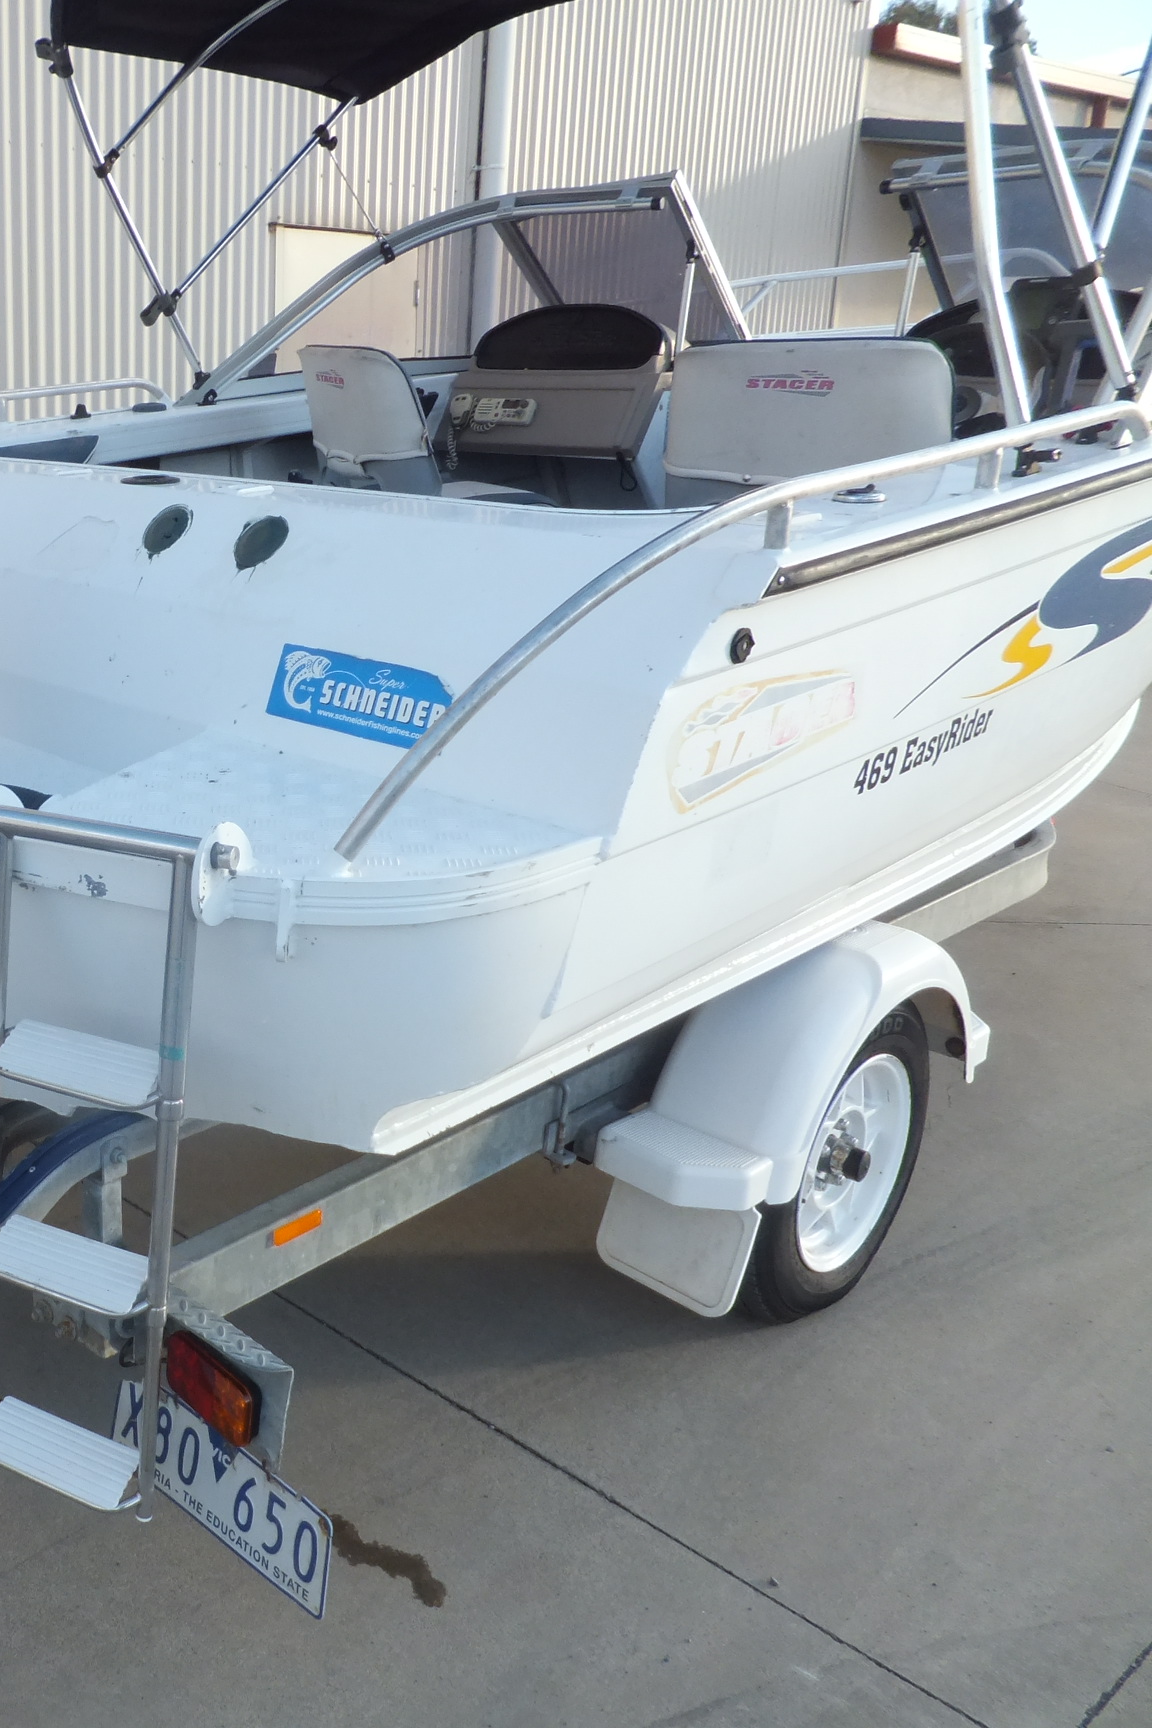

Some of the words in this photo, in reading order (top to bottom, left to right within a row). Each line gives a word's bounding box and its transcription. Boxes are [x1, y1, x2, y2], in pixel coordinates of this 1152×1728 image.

[315, 373, 345, 386] STACER
[746, 378, 835, 391] STACER
[319, 679, 445, 729] SCHNEIDER
[368, 669, 406, 690] Super
[853, 746, 898, 795] 469
[899, 708, 994, 775] EasyRider
[183, 1490, 202, 1515] THE
[206, 1512, 269, 1571] EDUCATION
[273, 1566, 310, 1601] STATE
[233, 1477, 318, 1583] 650
